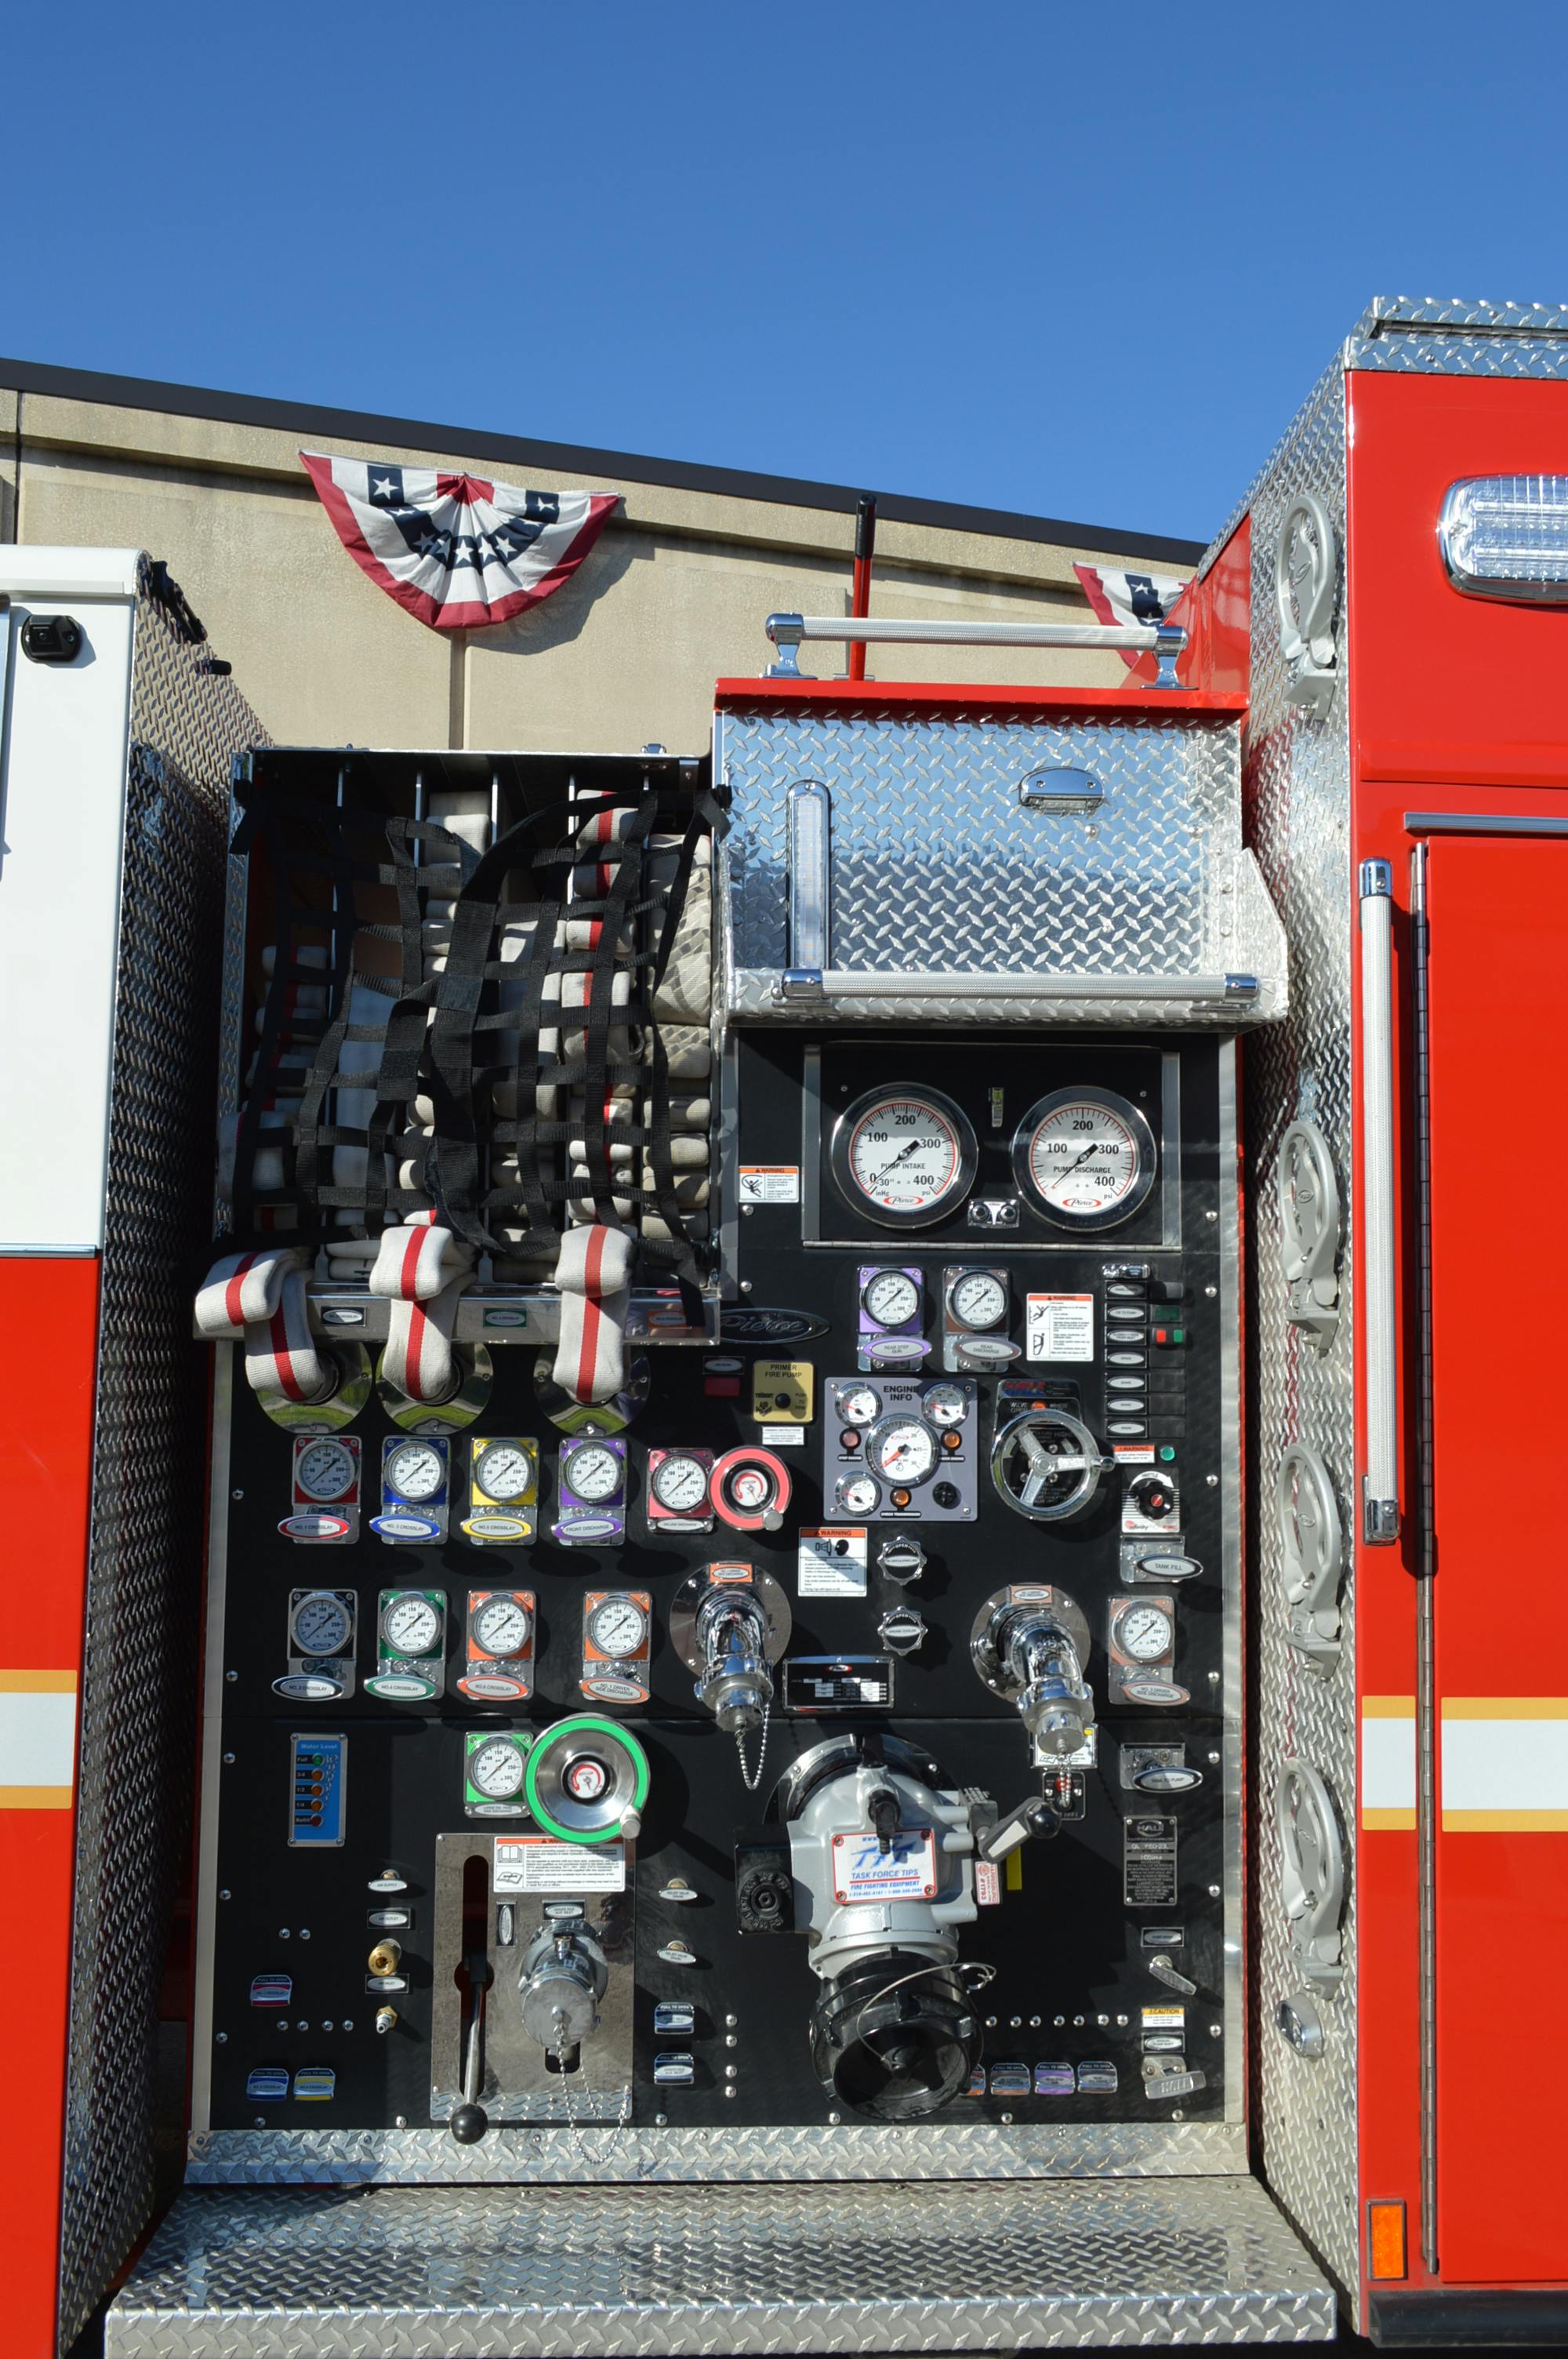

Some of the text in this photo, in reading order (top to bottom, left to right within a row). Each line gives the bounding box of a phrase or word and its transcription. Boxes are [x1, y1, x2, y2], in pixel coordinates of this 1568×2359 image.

[895, 1115, 916, 1125] 200
[1073, 1121, 1094, 1131] 200
[867, 1132, 888, 1142] 100
[920, 1139, 940, 1148] 300
[1047, 1143, 1067, 1154] 100
[1098, 1144, 1119, 1154] 300
[913, 1175, 935, 1185] 400
[1094, 1176, 1116, 1187] 400
[873, 1870, 899, 1879] FORCE
